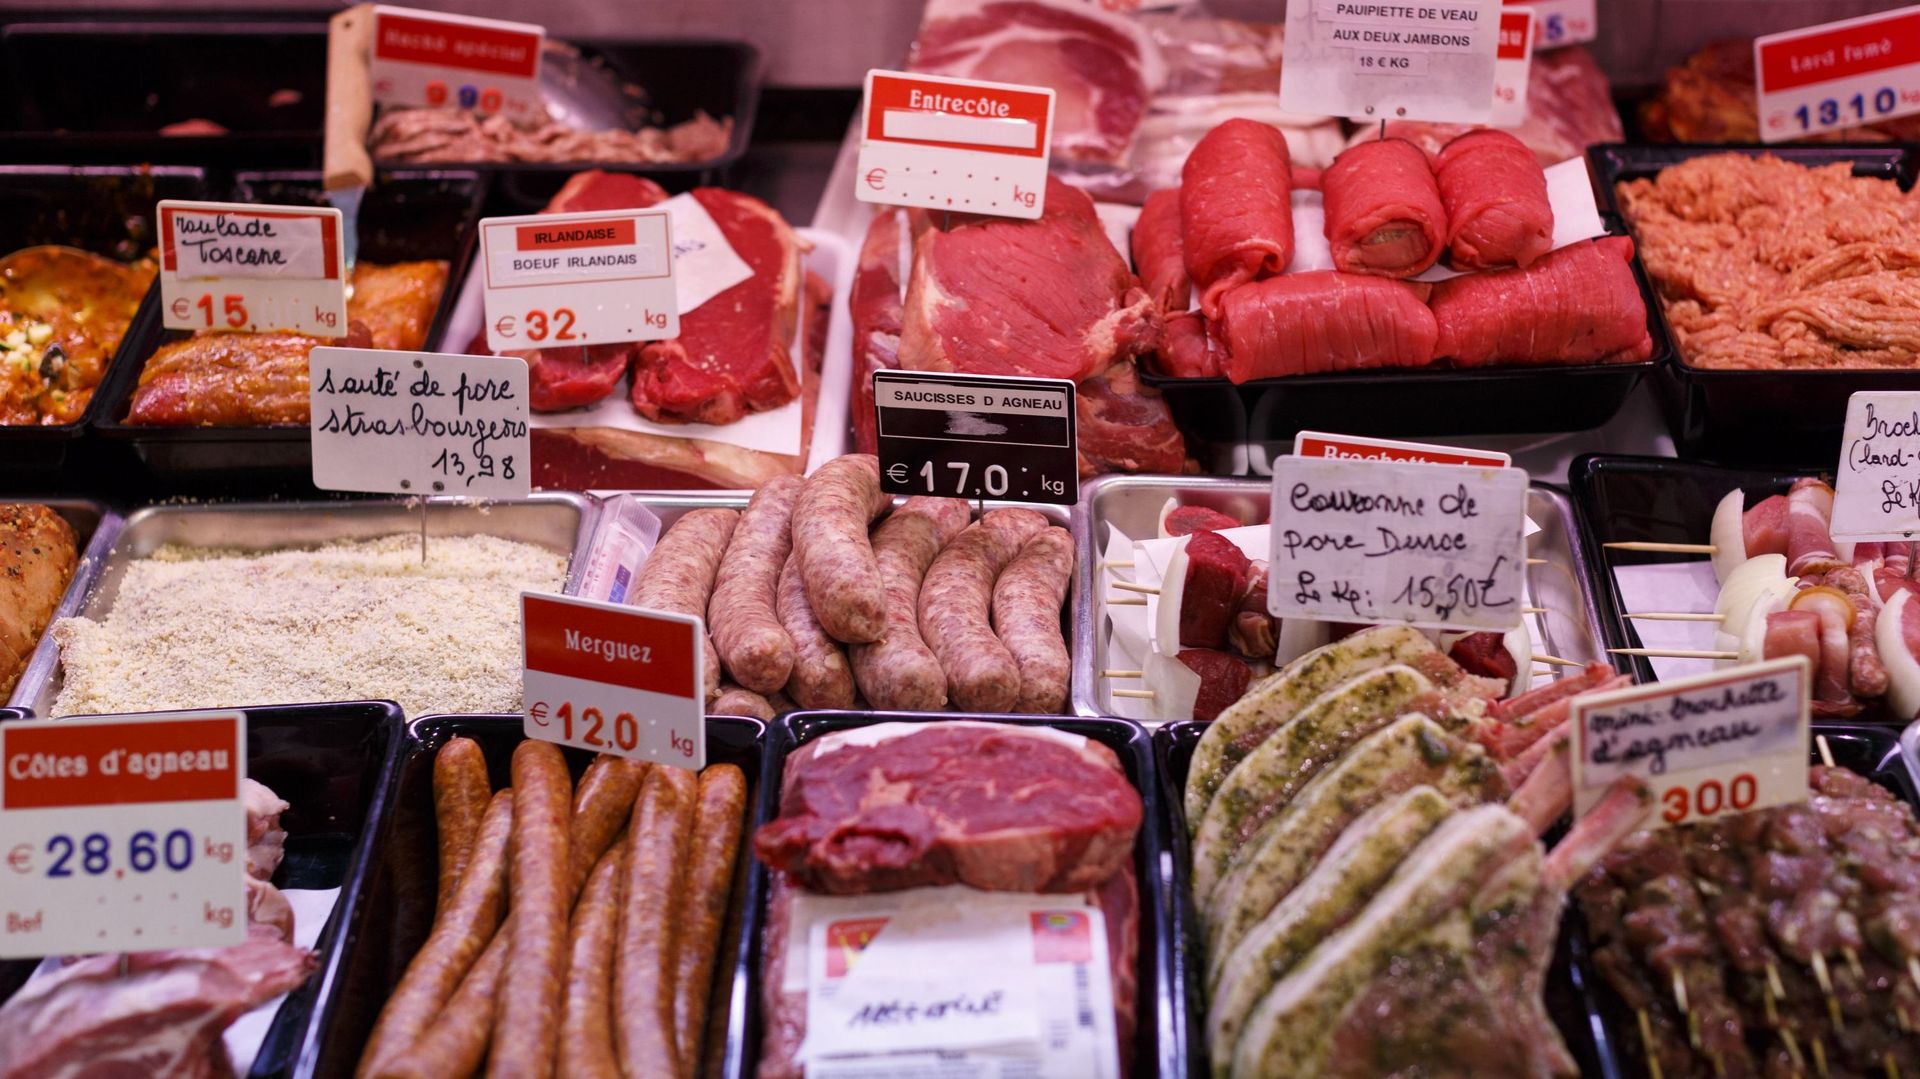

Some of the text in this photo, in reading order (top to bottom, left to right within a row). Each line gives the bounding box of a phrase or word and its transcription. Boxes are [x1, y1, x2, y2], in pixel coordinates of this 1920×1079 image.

[1418, 8, 1437, 19] DE
[1441, 9, 1478, 21] VEAU
[1332, 29, 1470, 46] AUX DEUX JAMBONS
[1359, 56, 1374, 67] 18
[1389, 57, 1409, 68] KG
[909, 89, 1010, 117] Entrecôte
[1014, 185, 1036, 207] kg
[534, 228, 617, 244] IRLANDAISE
[513, 254, 637, 271] BOEUF IRLANDAIS
[315, 306, 337, 328] kg
[645, 309, 667, 328] kg
[317, 367, 400, 397] sauté
[409, 369, 446, 397] de
[894, 390, 1063, 410] SAUCISSES D AGNEAU
[886, 463, 909, 484] €
[1041, 474, 1065, 496] kg
[1438, 483, 1479, 519] de
[565, 628, 652, 663] Merguez
[530, 701, 550, 727] €
[671, 729, 694, 757] kg
[9, 748, 230, 780] Côtes d'agneau
[204, 836, 234, 864] kg
[204, 900, 234, 929] kg
